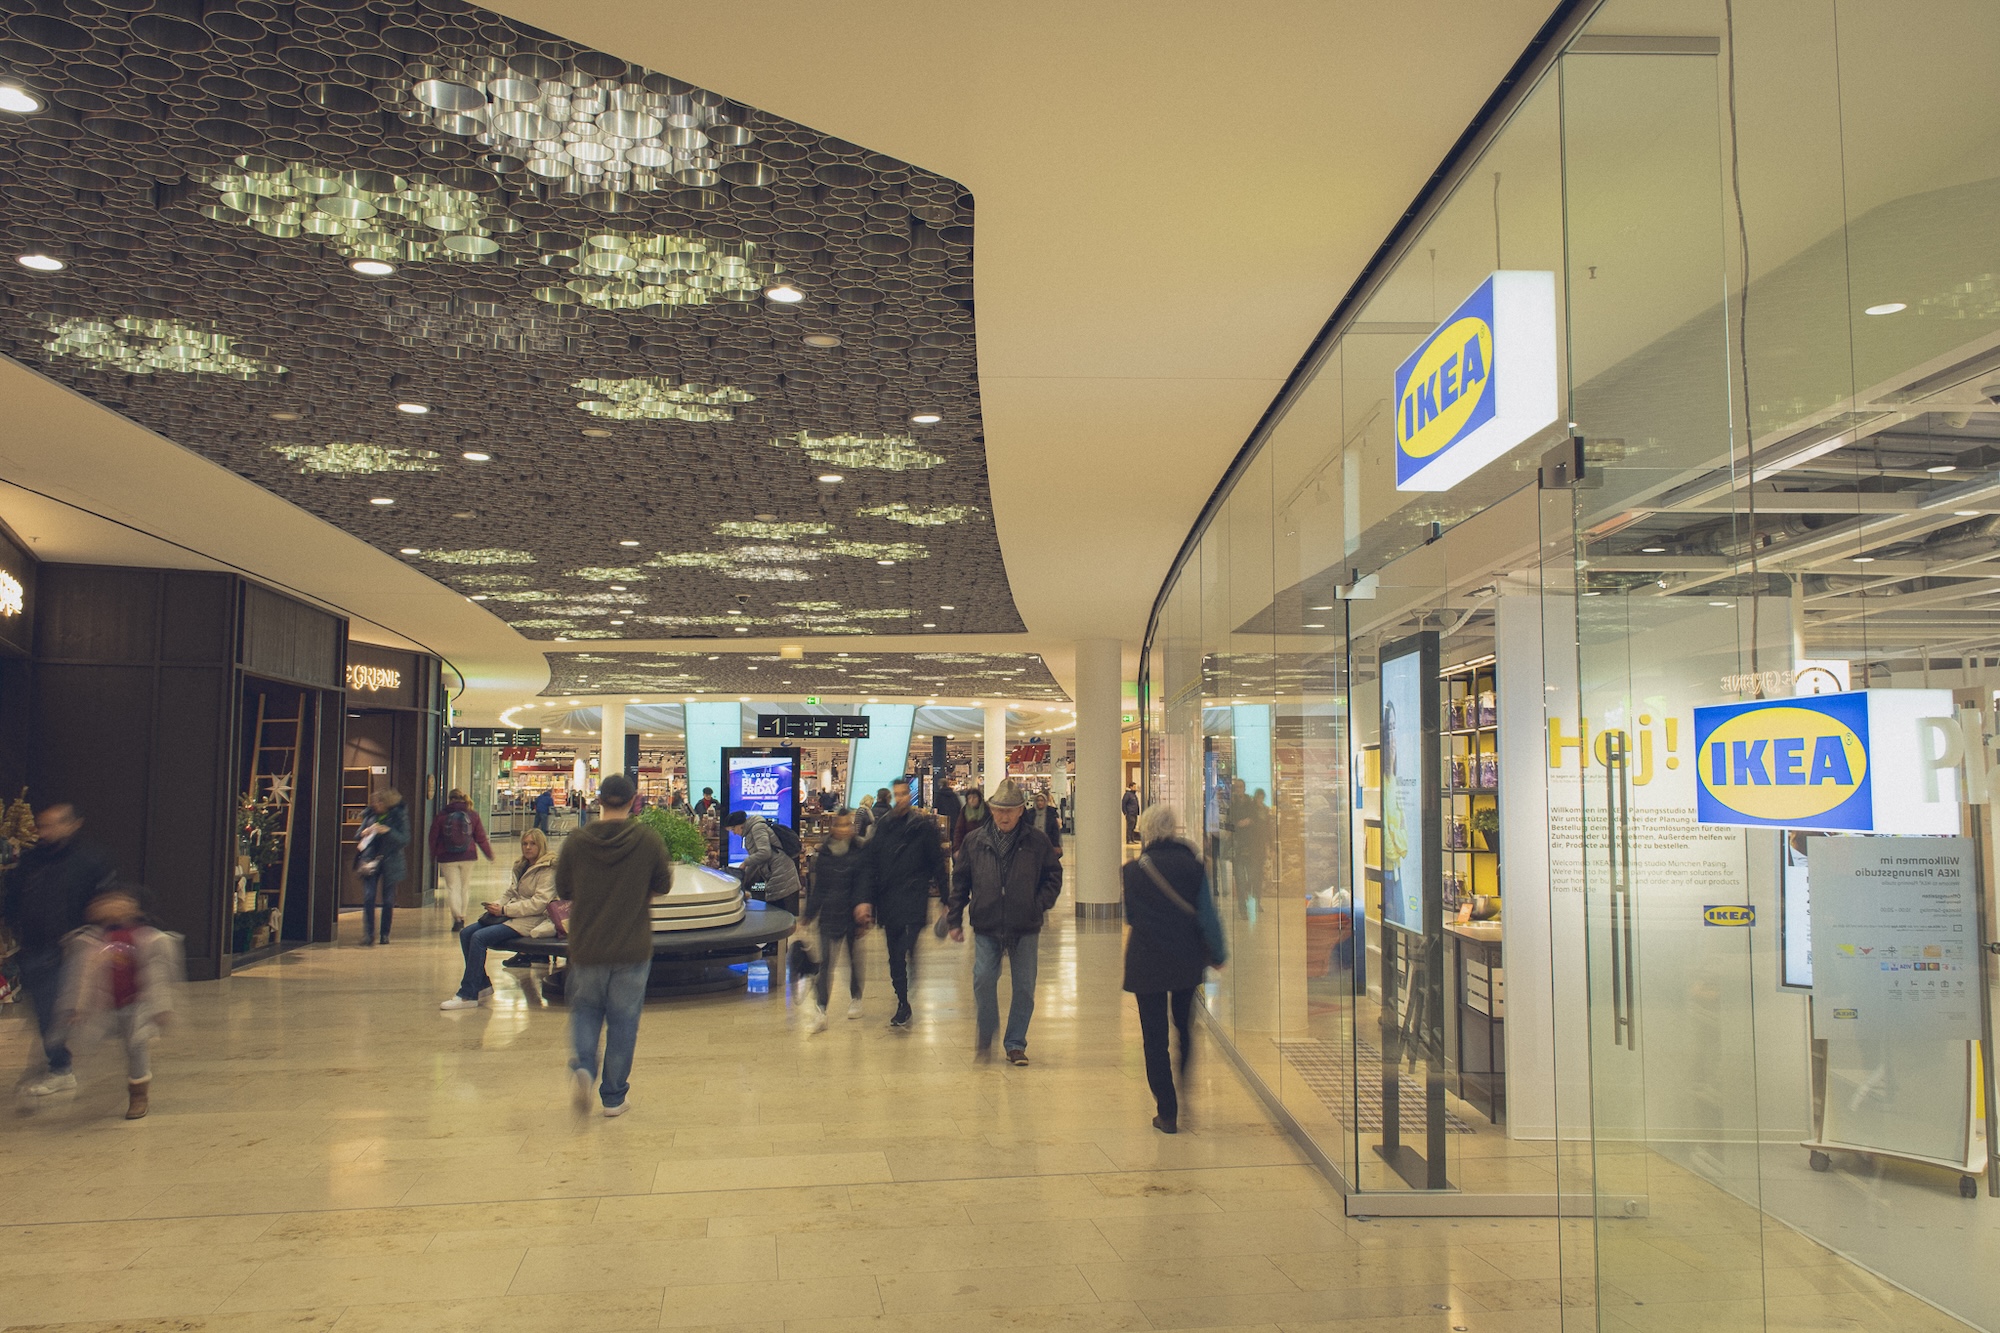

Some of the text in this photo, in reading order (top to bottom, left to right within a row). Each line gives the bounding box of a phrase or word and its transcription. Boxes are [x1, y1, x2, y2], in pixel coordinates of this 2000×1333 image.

[1405, 332, 1486, 442] IKEA
[351, 665, 401, 691] GRENE
[1549, 714, 1679, 786] Hej!
[1711, 735, 1855, 786] IKEA
[741, 778, 779, 787] BLACK
[741, 786, 778, 795] FRIDAY
[1659, 816, 1690, 824] Planung
[1642, 825, 1700, 833] Traumlösungen
[1708, 878, 1740, 886] products
[1708, 911, 1751, 920] IKEA
